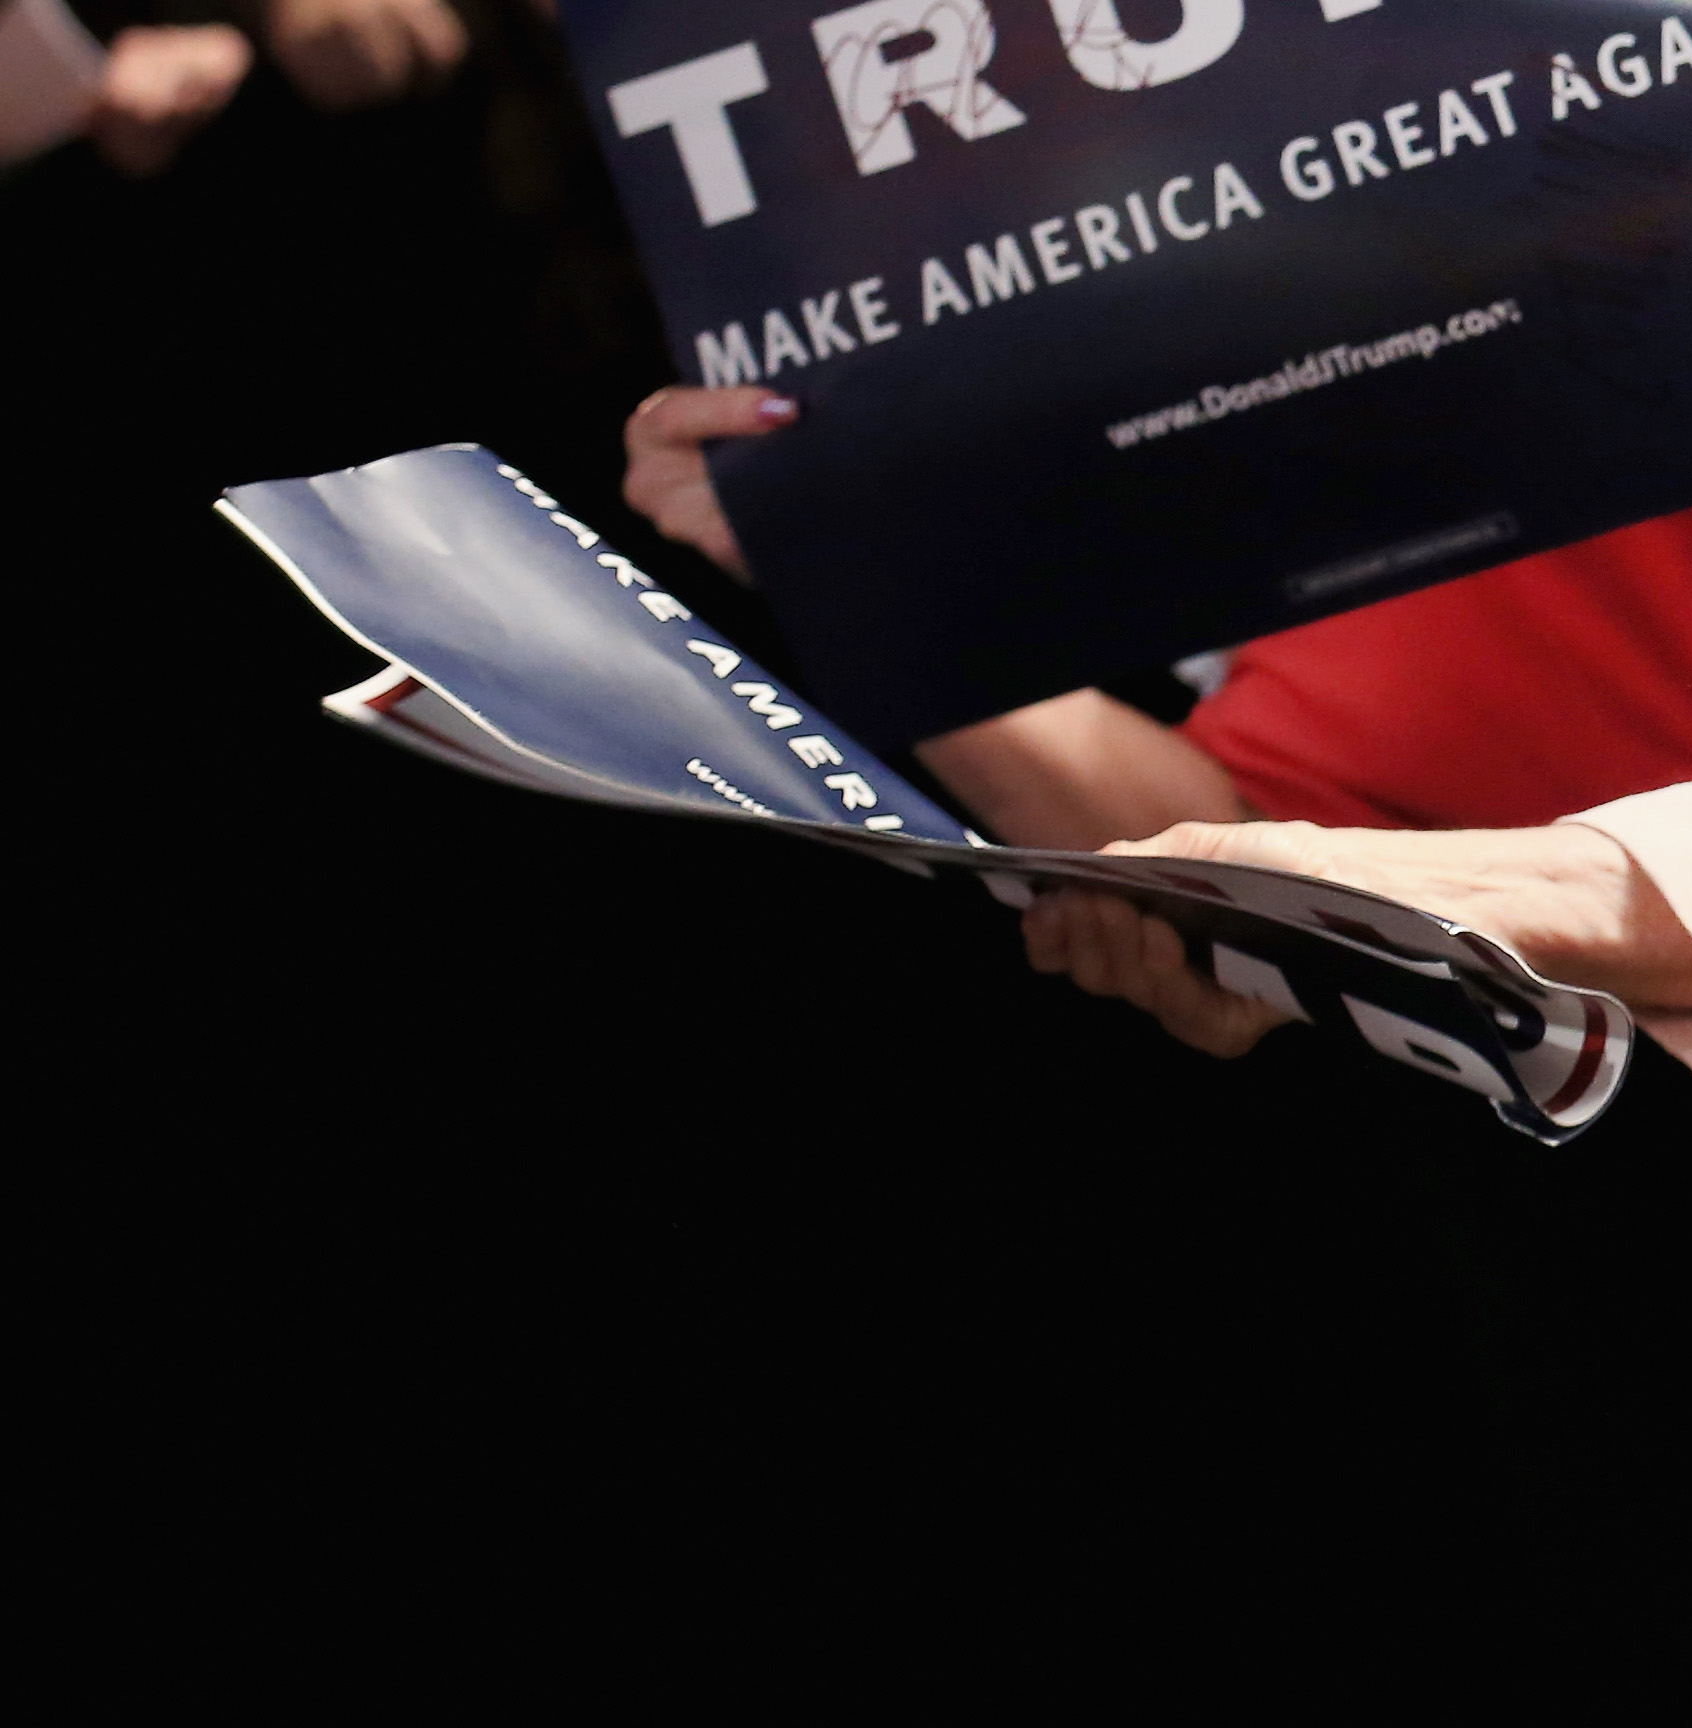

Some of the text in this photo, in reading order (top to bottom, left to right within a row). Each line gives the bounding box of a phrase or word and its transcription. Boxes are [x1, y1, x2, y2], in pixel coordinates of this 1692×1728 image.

[694, 277, 901, 391] MAKE
[920, 162, 1265, 327] AMERICA
[1279, 71, 1518, 203] GREAT
[1106, 298, 1523, 450] www.DonaldJTrump.com
[685, 637, 905, 833] AMERI
